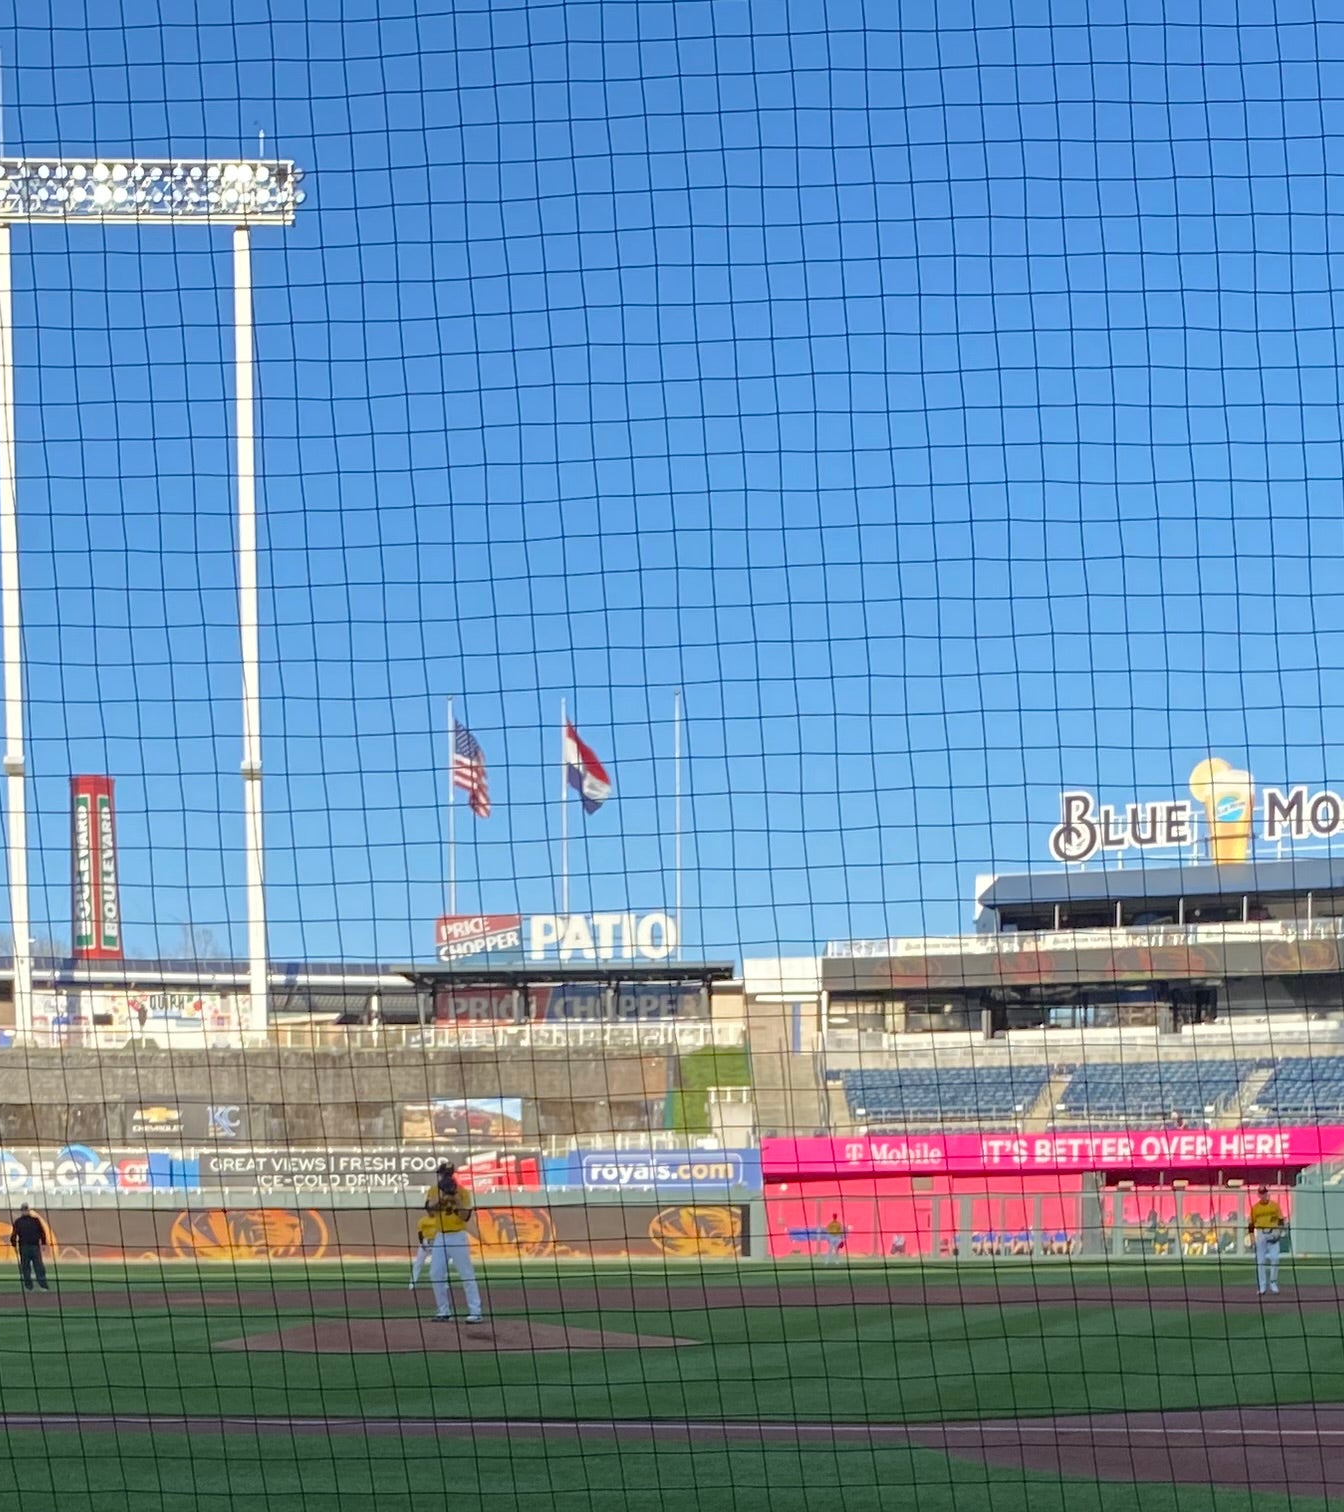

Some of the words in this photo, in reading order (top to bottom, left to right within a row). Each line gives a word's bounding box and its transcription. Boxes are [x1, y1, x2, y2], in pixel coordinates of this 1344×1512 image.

[1051, 792, 1191, 863] BLUE
[101, 805, 119, 937] BOULEVARD
[439, 917, 490, 941] PRICE
[529, 912, 677, 961] PATIO
[439, 931, 520, 962] CHOPPER
[132, 1124, 184, 1133] CHEVROLET
[207, 1105, 241, 1138] KC
[209, 1156, 268, 1173] GREAT
[270, 1156, 327, 1173] VIEWS
[339, 1156, 397, 1172] FRESH
[870, 1143, 942, 1166] Mobile
[1034, 1137, 1137, 1164] BETTER
[1140, 1135, 1214, 1162] OVER
[1220, 1133, 1291, 1160] HERE
[2, 1160, 110, 1190] DECK
[124, 1164, 148, 1184] QT
[257, 1174, 341, 1187] ICE-COLD
[345, 1173, 410, 1187] DRINKS
[591, 1160, 735, 1184] royals.com
